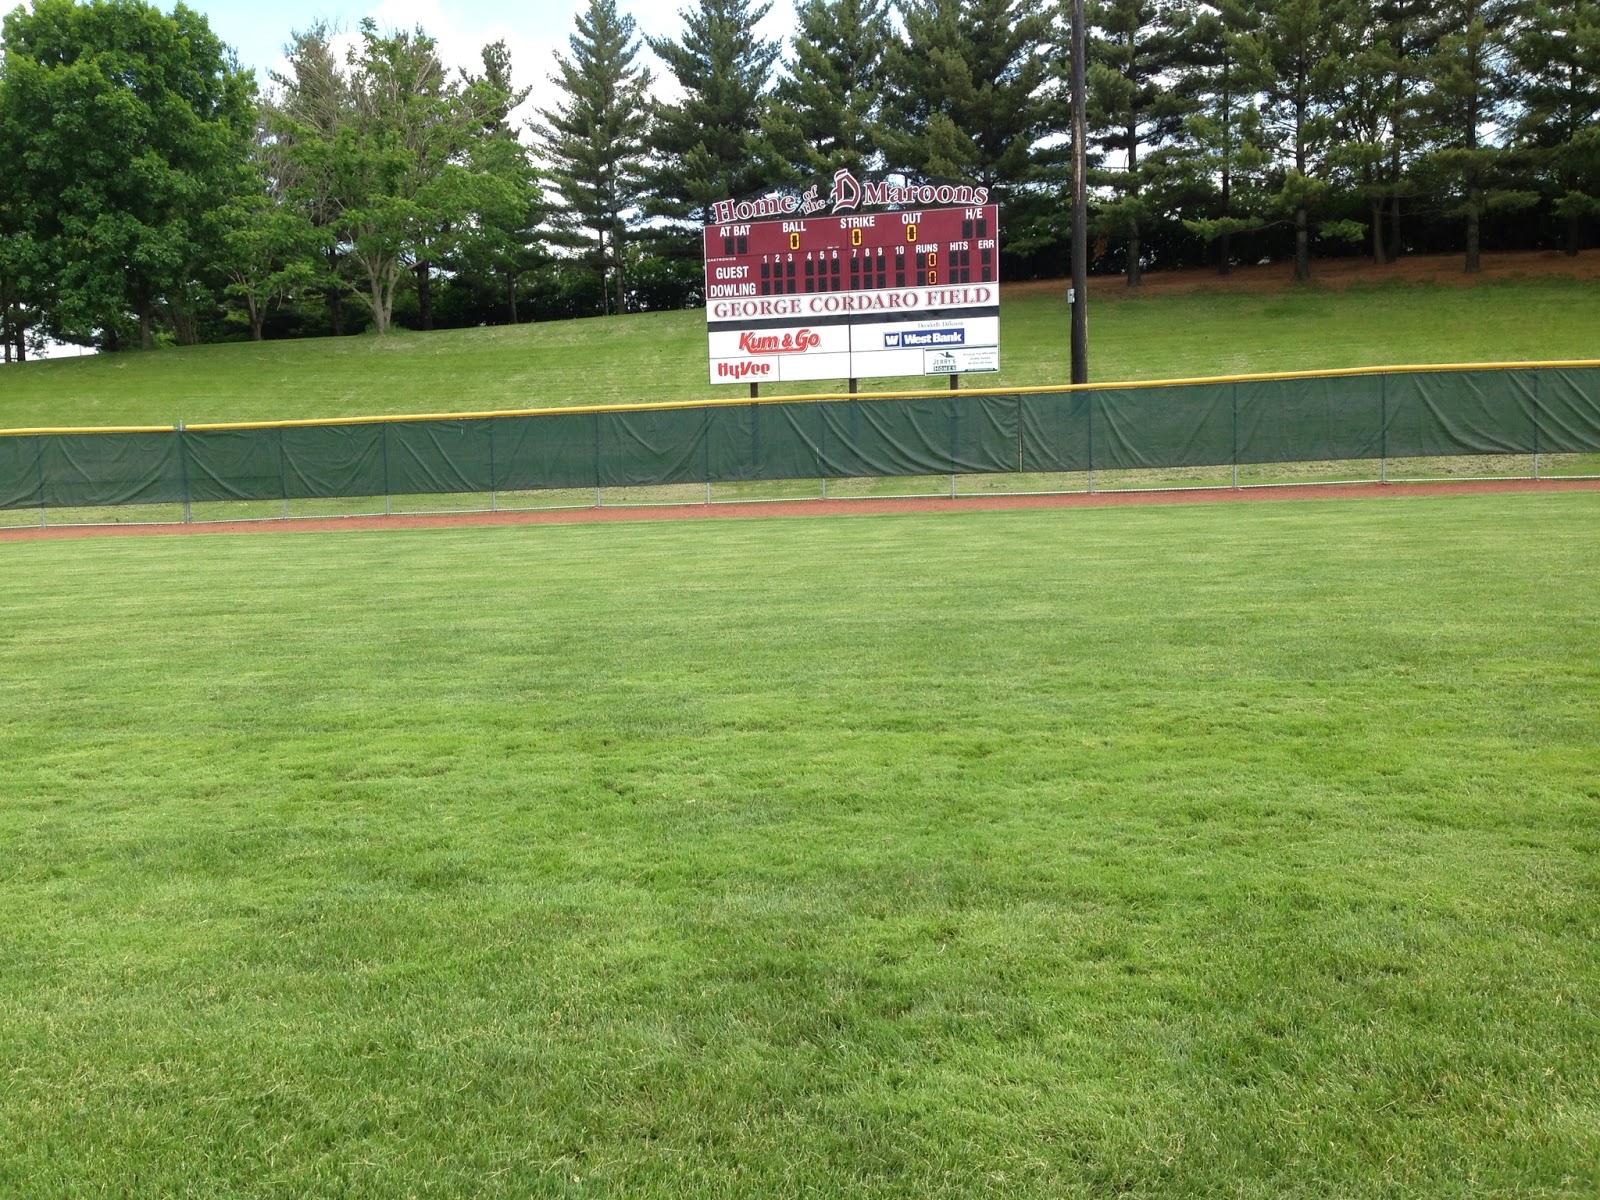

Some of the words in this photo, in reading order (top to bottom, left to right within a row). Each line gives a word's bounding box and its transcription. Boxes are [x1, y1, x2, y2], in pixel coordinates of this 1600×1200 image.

[802, 184, 818, 201] of
[863, 182, 989, 205] Maroons
[712, 198, 796, 224] Home
[801, 199, 826, 215] the
[966, 208, 983, 220] H/E
[840, 216, 875, 229] STRIKE
[902, 213, 922, 224] OUT
[720, 227, 731, 237] AT
[734, 225, 751, 236] BAT
[782, 221, 806, 233] BALL
[907, 224, 917, 242] 0
[790, 232, 800, 250] 0
[852, 228, 862, 246] 0
[775, 254, 780, 263] 2
[787, 253, 793, 262] 3
[806, 252, 812, 260] 4
[820, 251, 825, 260] 5
[832, 250, 838, 259] 6
[852, 249, 857, 258] 7
[865, 248, 870, 257] 8
[877, 247, 883, 256] 9
[895, 246, 905, 255] 10
[916, 243, 938, 253] RUNS
[950, 241, 969, 251] HITS
[978, 240, 995, 249] ERR
[716, 266, 749, 279] GUEST
[710, 282, 756, 297] DOWLING
[714, 298, 801, 318] GEORGE
[809, 291, 919, 313] CORDARO
[925, 287, 991, 307] FIELD
[739, 331, 779, 352] Kum
[782, 333, 793, 349] &
[795, 328, 821, 351] Go
[885, 335, 899, 346] W
[904, 333, 932, 345] West
[932, 332, 962, 343] Bank
